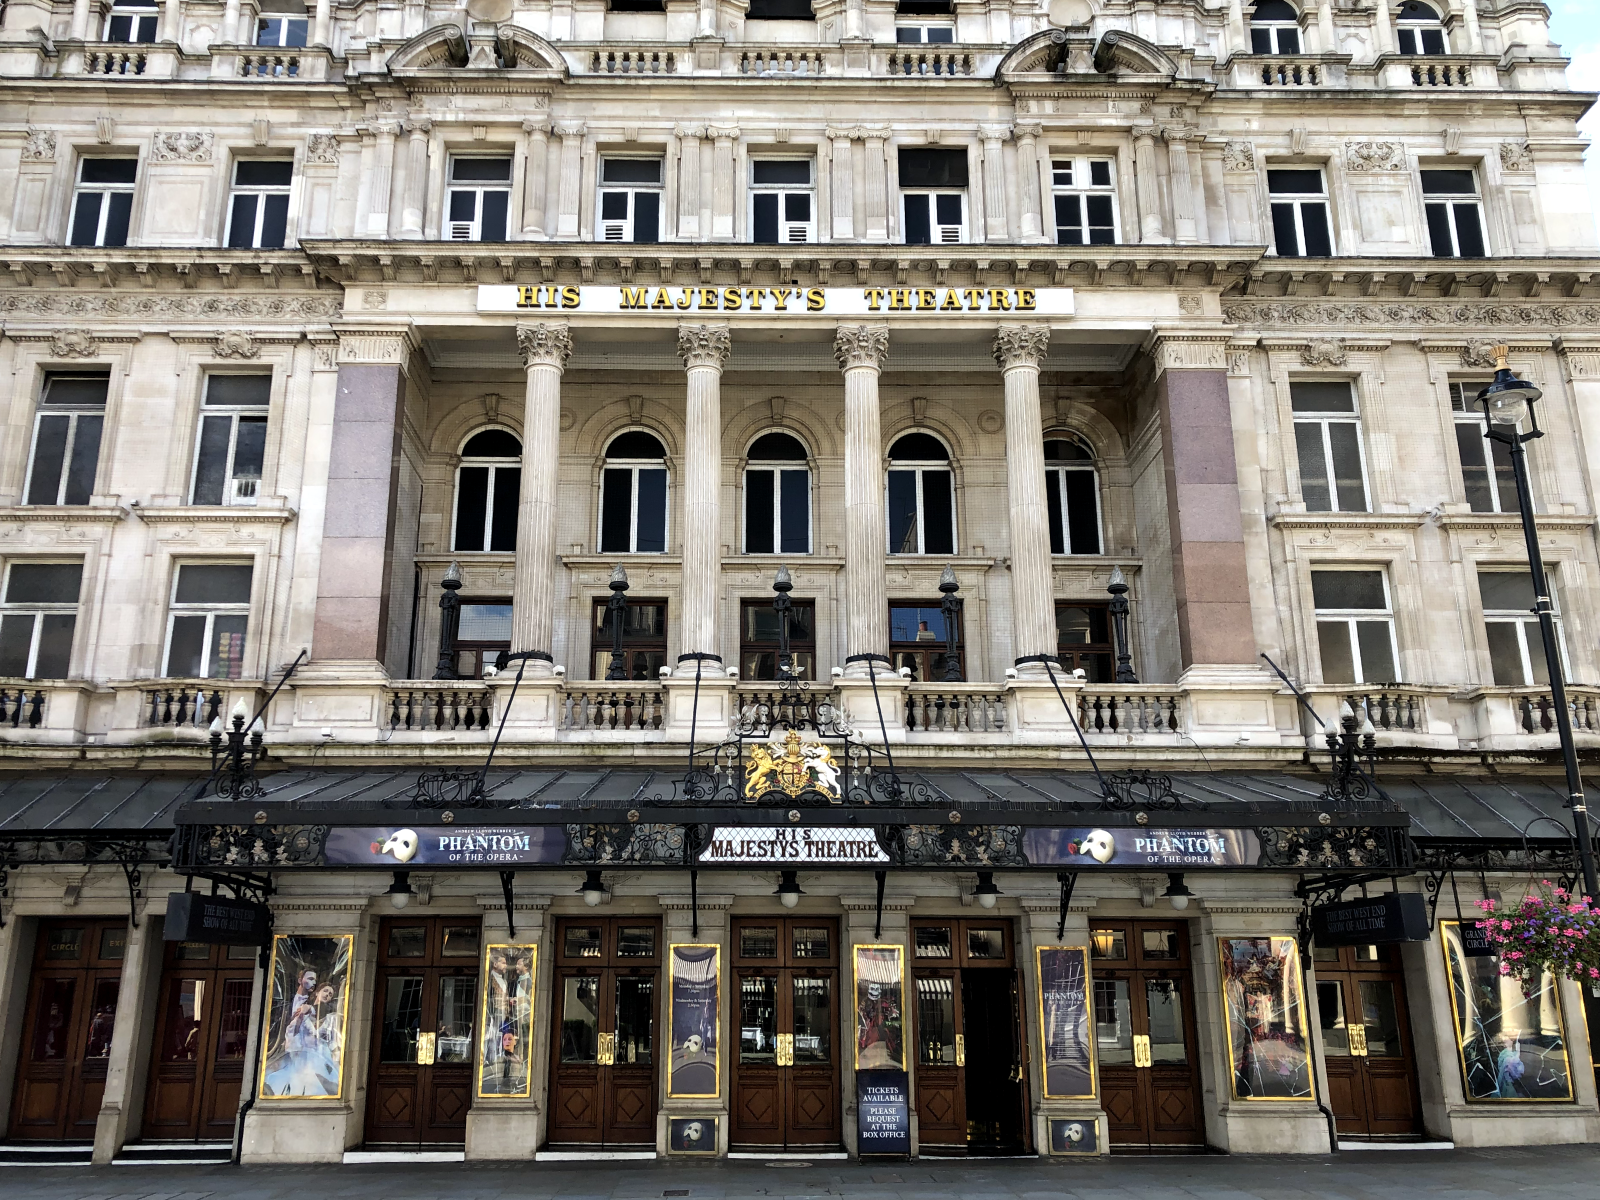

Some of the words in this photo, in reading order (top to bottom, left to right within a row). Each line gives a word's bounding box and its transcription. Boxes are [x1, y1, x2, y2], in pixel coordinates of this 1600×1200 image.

[516, 285, 581, 309] HIS
[619, 286, 826, 312] MAJESTY'S
[864, 288, 1037, 312] THEATRE
[775, 828, 812, 840] HIS
[438, 835, 531, 851] PHANTOM
[1134, 837, 1227, 853] PHANTOM
[805, 840, 879, 858] THEATRE
[448, 853, 462, 861] OF
[465, 853, 484, 861] THE
[486, 853, 519, 861] OPERA
[1147, 855, 1160, 863] OF
[1163, 855, 1182, 863] THE
[1184, 855, 1216, 863] OPERA
[216, 905, 229, 918] BEST
[229, 907, 245, 920] WEST
[1338, 908, 1353, 921] BEST
[1353, 906, 1371, 919] WEST
[1371, 904, 1386, 917] END
[202, 916, 219, 929] SHOW
[220, 918, 228, 930] OF
[1327, 921, 1345, 933] SHOW
[1346, 920, 1354, 932] OF
[1355, 919, 1368, 931] ALL
[1465, 929, 1488, 939] GRAND
[51, 943, 79, 951] CIRCLE
[1466, 939, 1490, 949] CIRCLE
[1044, 992, 1085, 1000] PHANTOM
[866, 1086, 899, 1094] TICKETS
[863, 1094, 904, 1102] AVAILABLE
[870, 1107, 897, 1115] PLEASE
[867, 1115, 900, 1123] REQUEST
